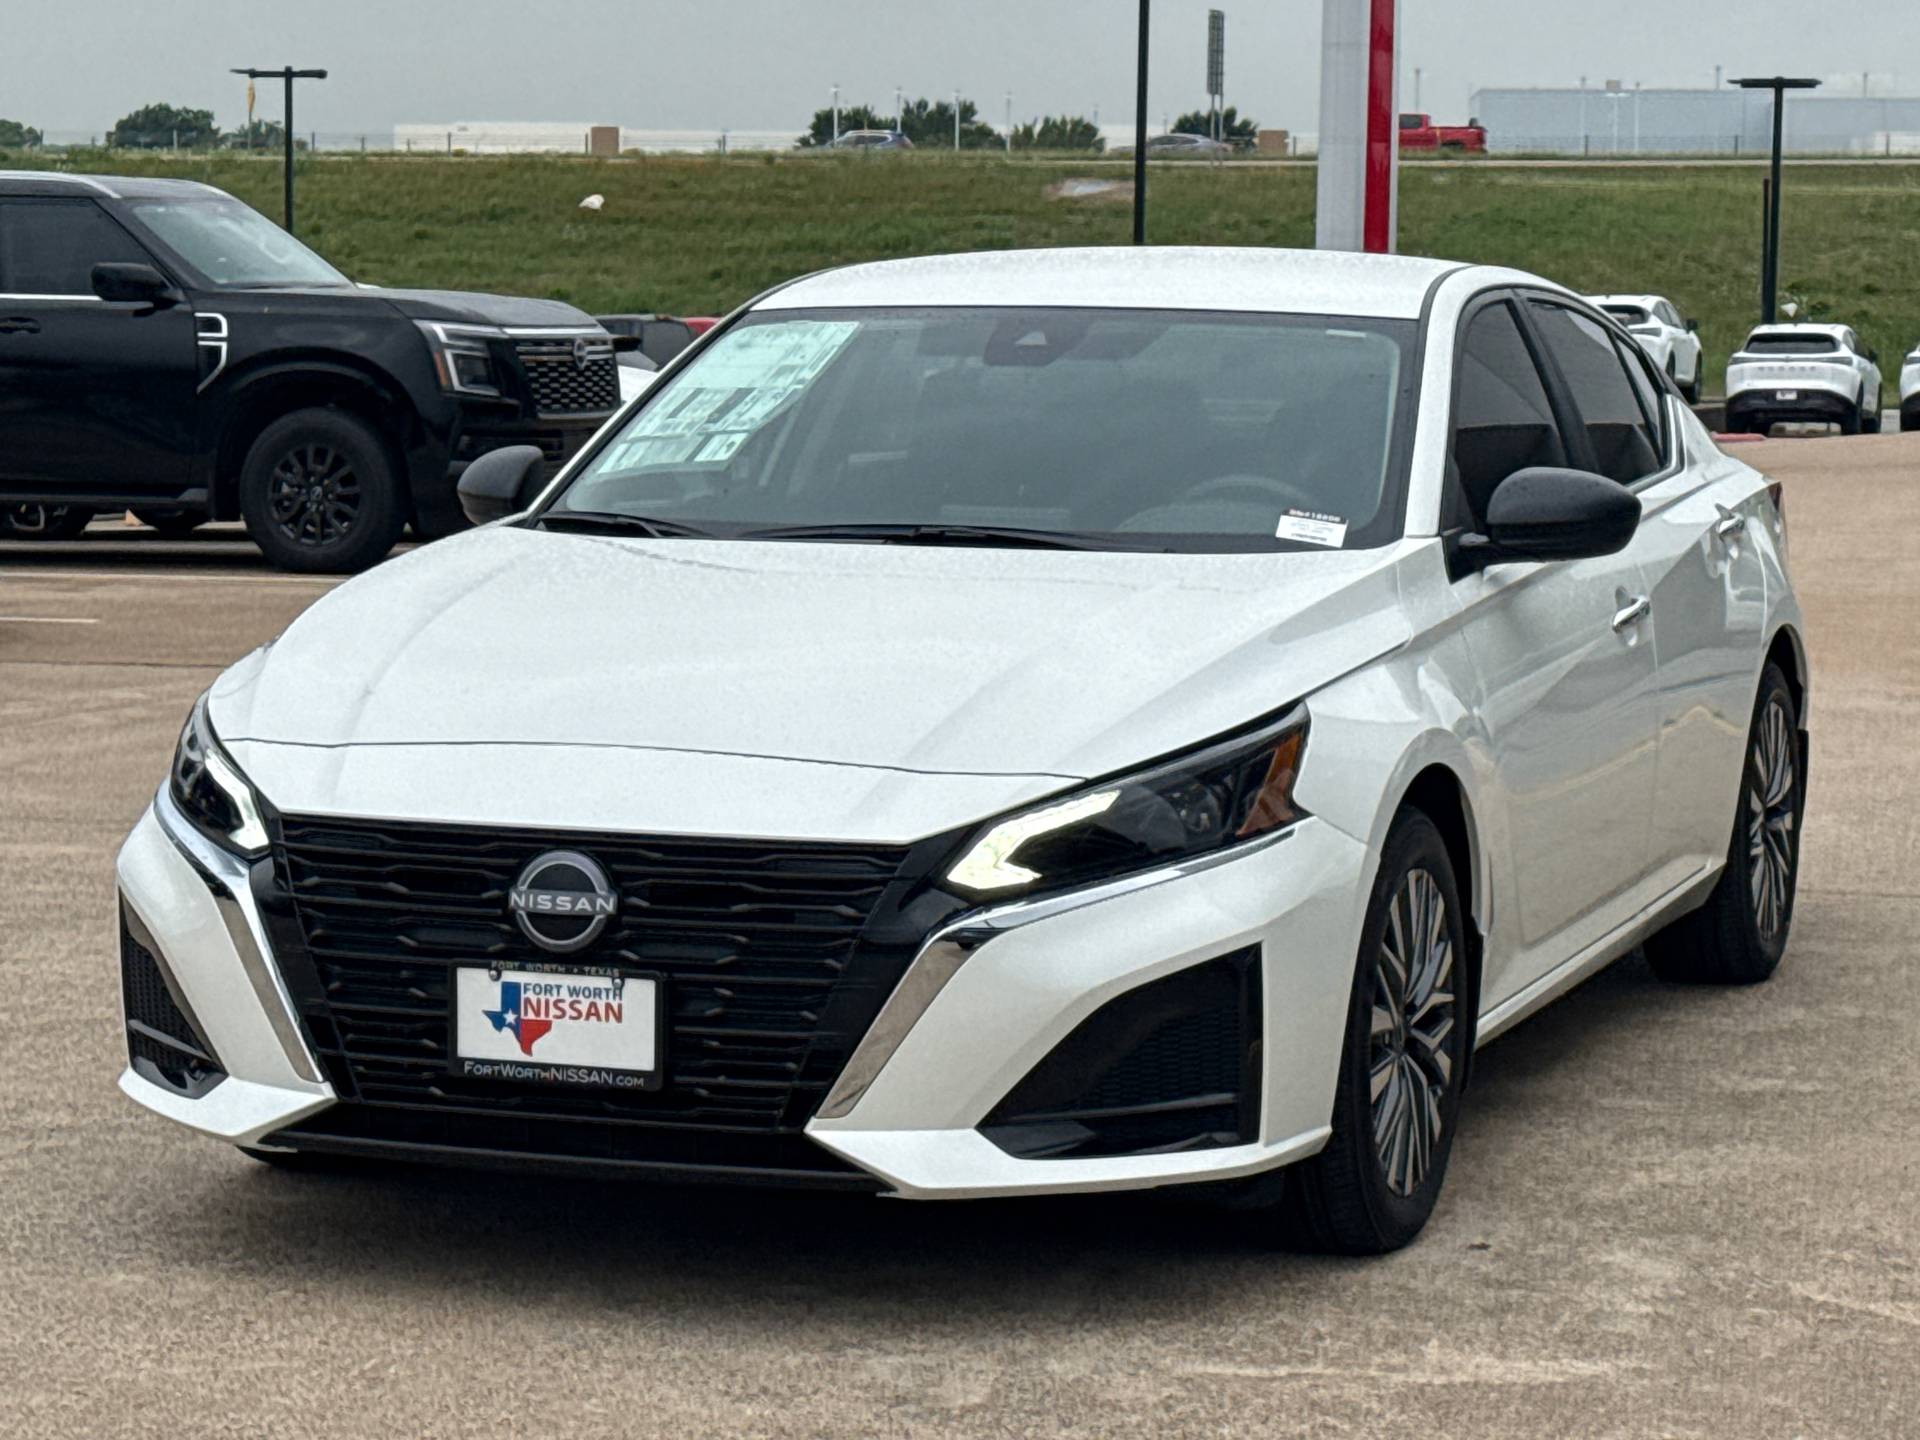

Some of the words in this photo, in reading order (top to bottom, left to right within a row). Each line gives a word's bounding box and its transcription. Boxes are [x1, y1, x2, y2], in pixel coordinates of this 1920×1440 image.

[510, 891, 615, 912] NISSAN
[491, 961, 520, 971] FORT
[525, 962, 566, 974] WORTH
[583, 966, 620, 977] TEXAS
[523, 982, 563, 997] FORT
[567, 984, 623, 1001] WORTH
[523, 996, 623, 1023] NISSAN
